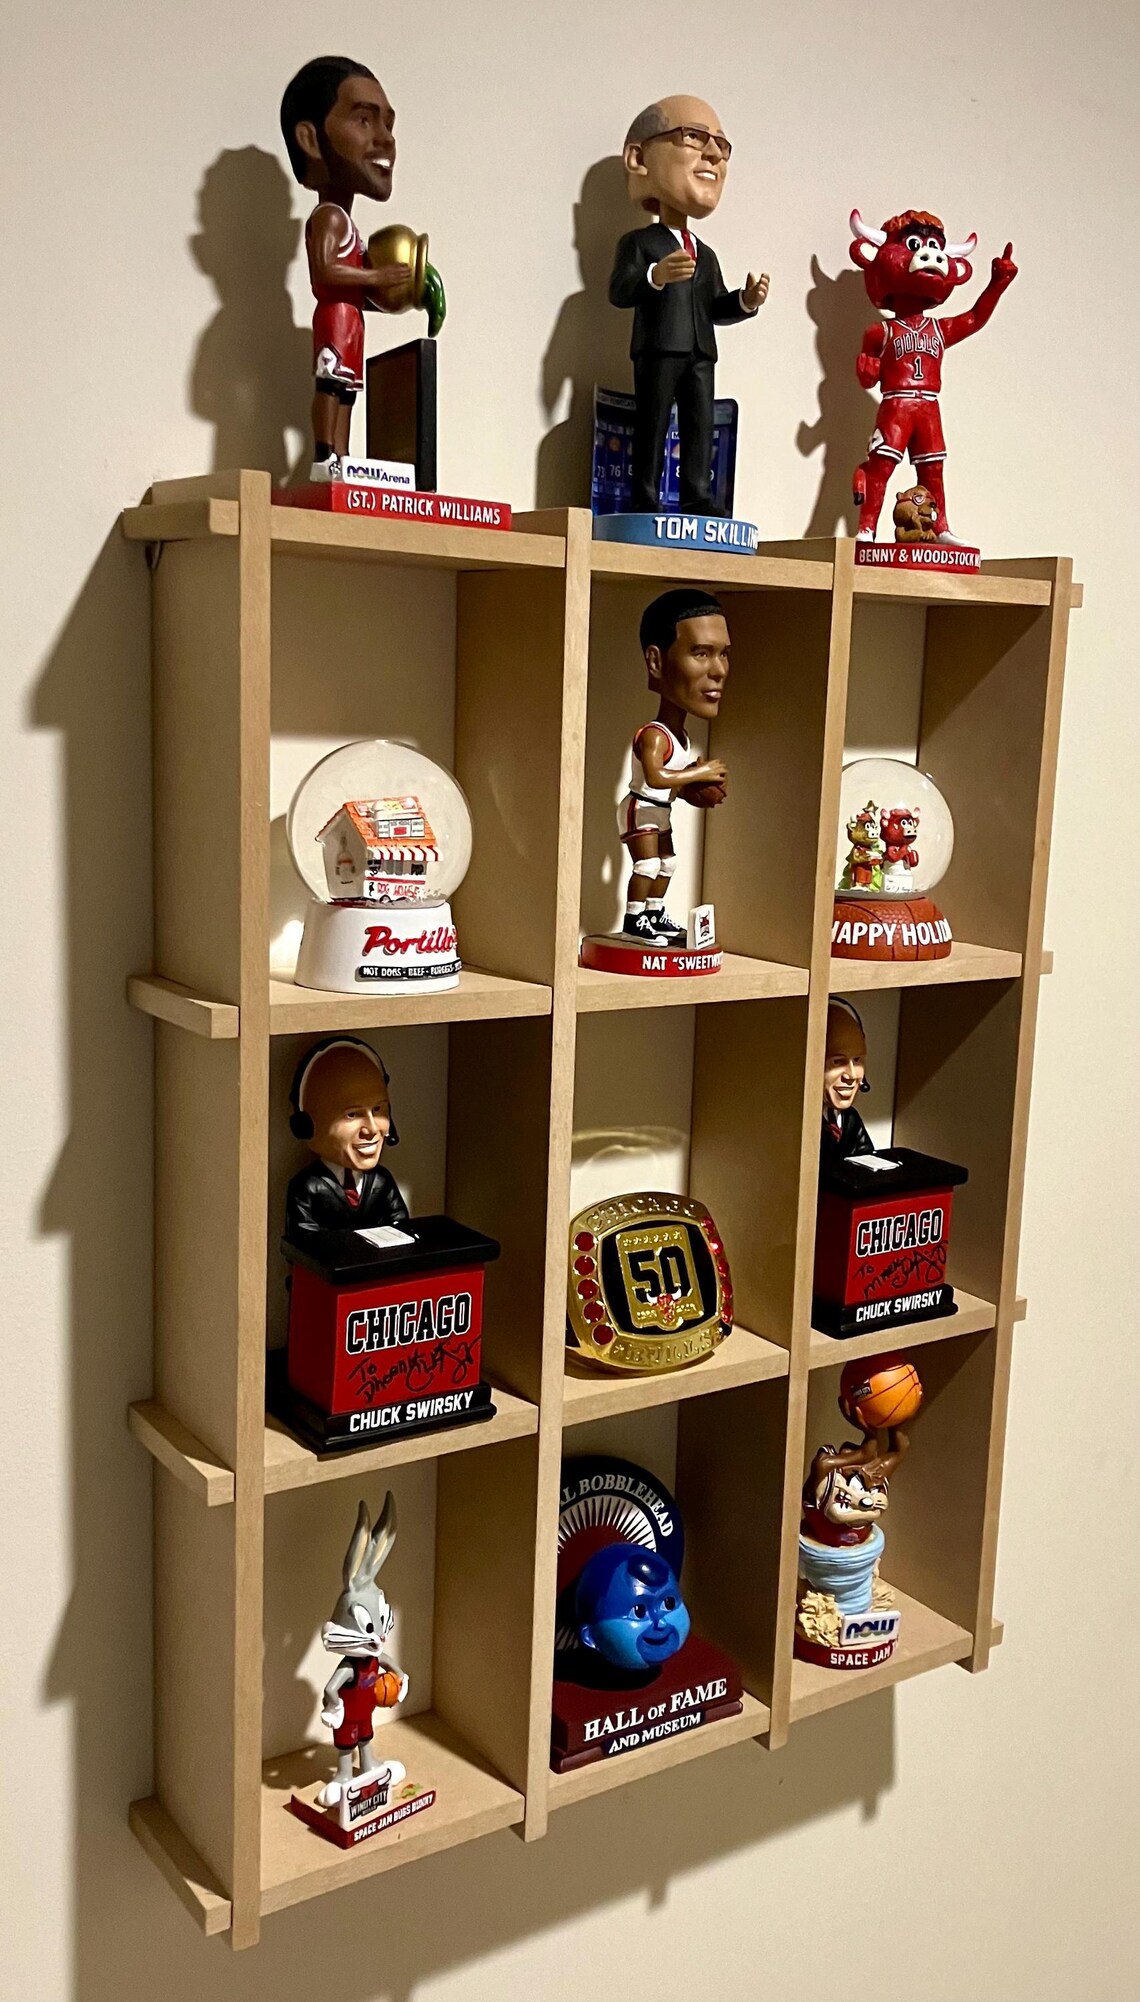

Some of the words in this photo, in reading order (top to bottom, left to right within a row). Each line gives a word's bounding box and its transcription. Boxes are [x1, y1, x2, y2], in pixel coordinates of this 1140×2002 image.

[894, 331, 940, 360] BULLS
[914, 355, 924, 379] 1
[380, 470, 410, 485] Arena
[609, 464, 621, 477] 76
[347, 489, 376, 511] (ST.)
[382, 493, 434, 518] PATRICK
[439, 500, 501, 525] WILLIAMS
[654, 516, 698, 540] TOM
[859, 548, 896, 563] BENNY
[898, 548, 909, 563] &
[911, 548, 975, 567] WOODSTOCK
[363, 967, 379, 976] HOT
[642, 955, 668, 970] NAT
[855, 1207, 944, 1258] CHICAGO
[625, 1244, 693, 1304] 50
[855, 1299, 892, 1323] CHUCK
[893, 1289, 943, 1313] SWIRSKY
[345, 1292, 472, 1355] CHICAGO
[349, 1405, 400, 1432] CHUCK
[405, 1390, 474, 1422] SWIRSKY
[579, 1474, 674, 1537] BOBBLEHEAD
[830, 1652, 869, 1666] SPACE
[871, 1645, 891, 1663] JAM
[583, 1707, 645, 1742] HALL
[647, 1703, 667, 1720] OF
[669, 1678, 727, 1713] FAME
[608, 1733, 640, 1754] AND
[641, 1712, 702, 1743] MUSEUM
[350, 1798, 372, 1819] WINDY
[373, 1790, 387, 1805] CITY
[353, 1822, 377, 1841] SPACE
[377, 1813, 393, 1829] JAM
[393, 1804, 411, 1822] BUGS
[411, 1793, 434, 1812] BUNNY
